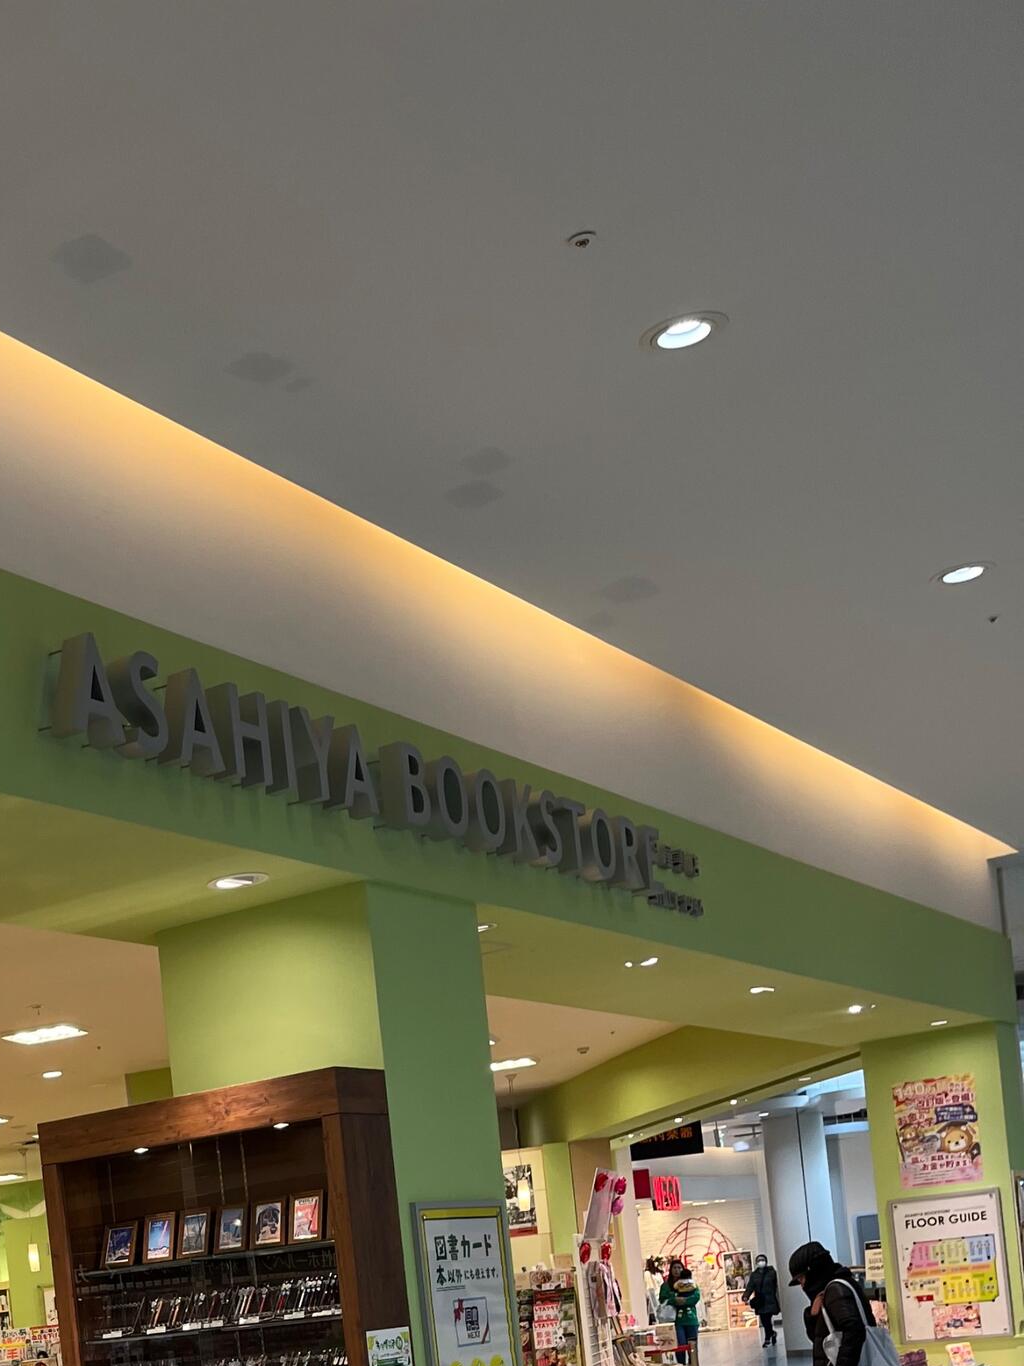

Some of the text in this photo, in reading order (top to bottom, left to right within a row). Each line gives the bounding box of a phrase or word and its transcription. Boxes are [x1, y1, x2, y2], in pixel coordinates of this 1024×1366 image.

[51, 631, 666, 896] ASAHIYA BOOKSTORE
[905, 1211, 987, 1229] FLOOR GUIDE
[434, 1234, 492, 1260] 図書カード
